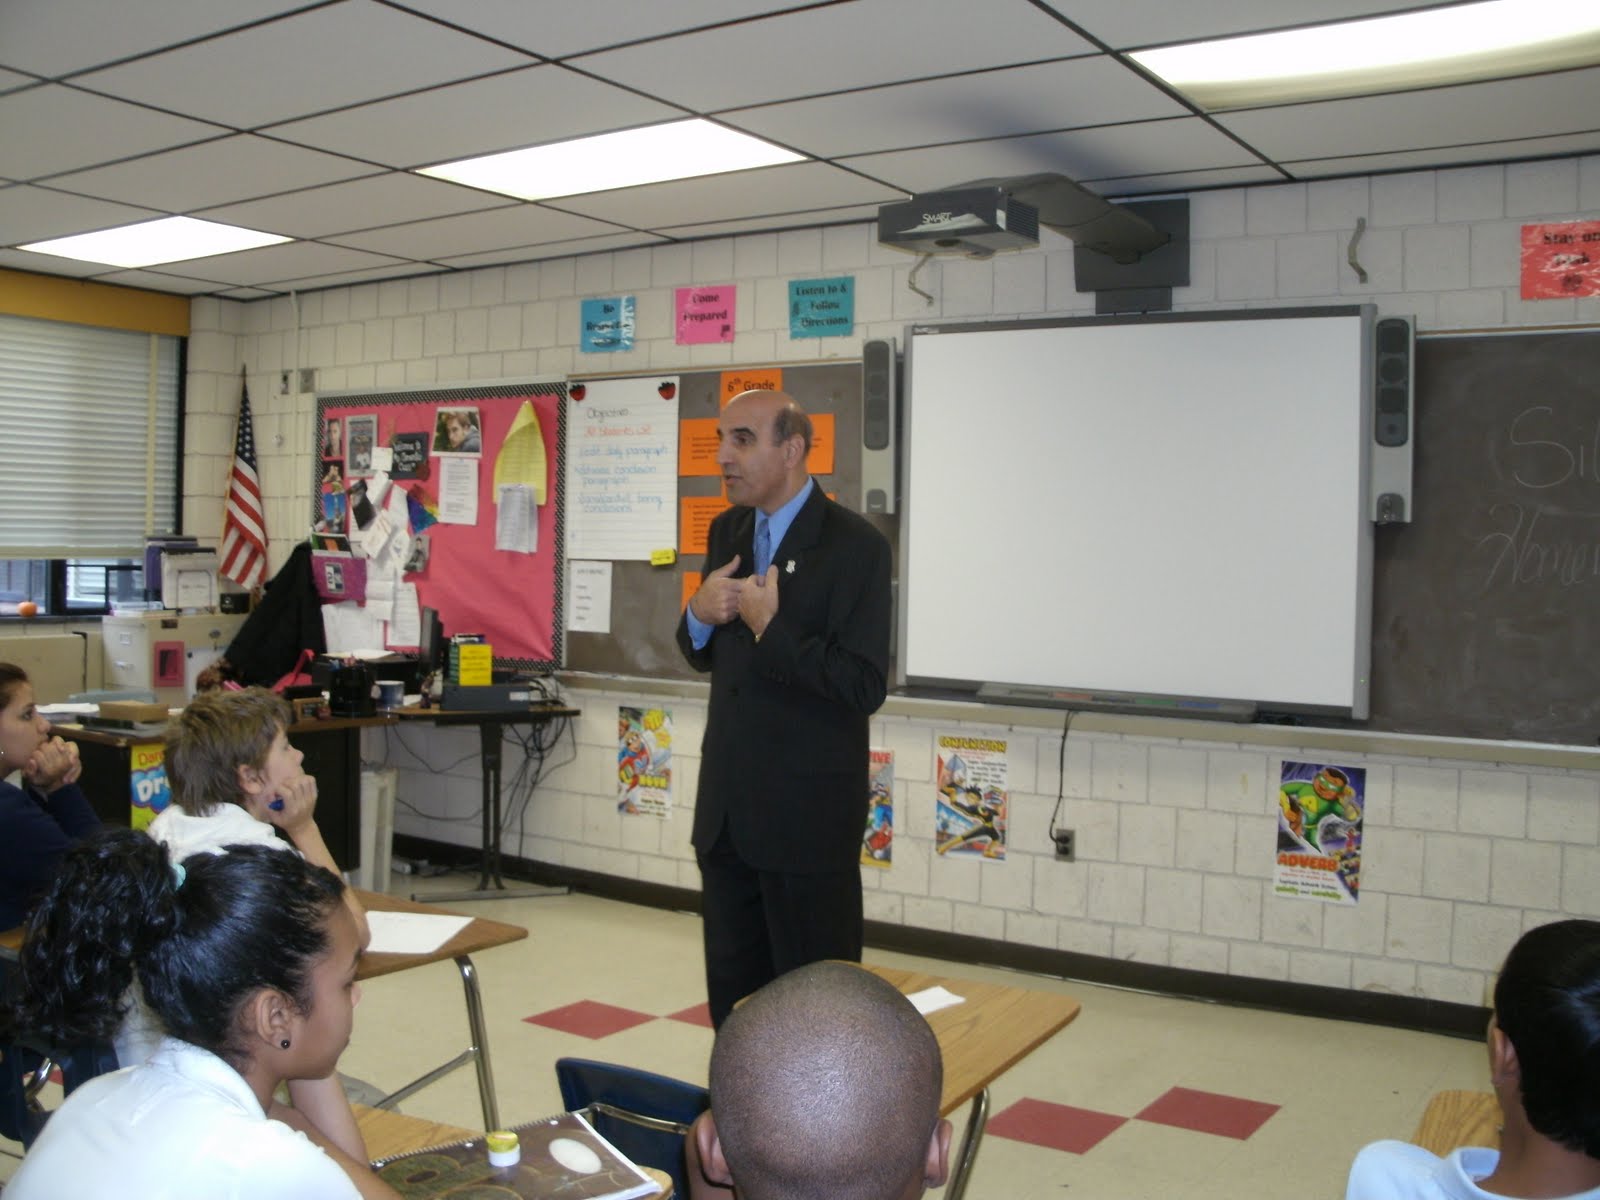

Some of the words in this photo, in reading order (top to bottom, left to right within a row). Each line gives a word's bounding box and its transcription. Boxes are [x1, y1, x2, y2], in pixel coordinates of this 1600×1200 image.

[922, 212, 952, 224] SMART
[1543, 232, 1575, 245] Stay
[796, 287, 825, 297] Listen
[827, 285, 838, 294] to
[840, 283, 848, 293] &
[692, 293, 720, 304] Come
[602, 304, 615, 314] Be
[810, 300, 840, 310] Follow
[683, 309, 728, 323] Prepared
[801, 317, 848, 329] Directions
[744, 379, 775, 391] Grade
[939, 736, 1007, 754] CONJUNCTION
[1277, 854, 1339, 872] ADVERB
